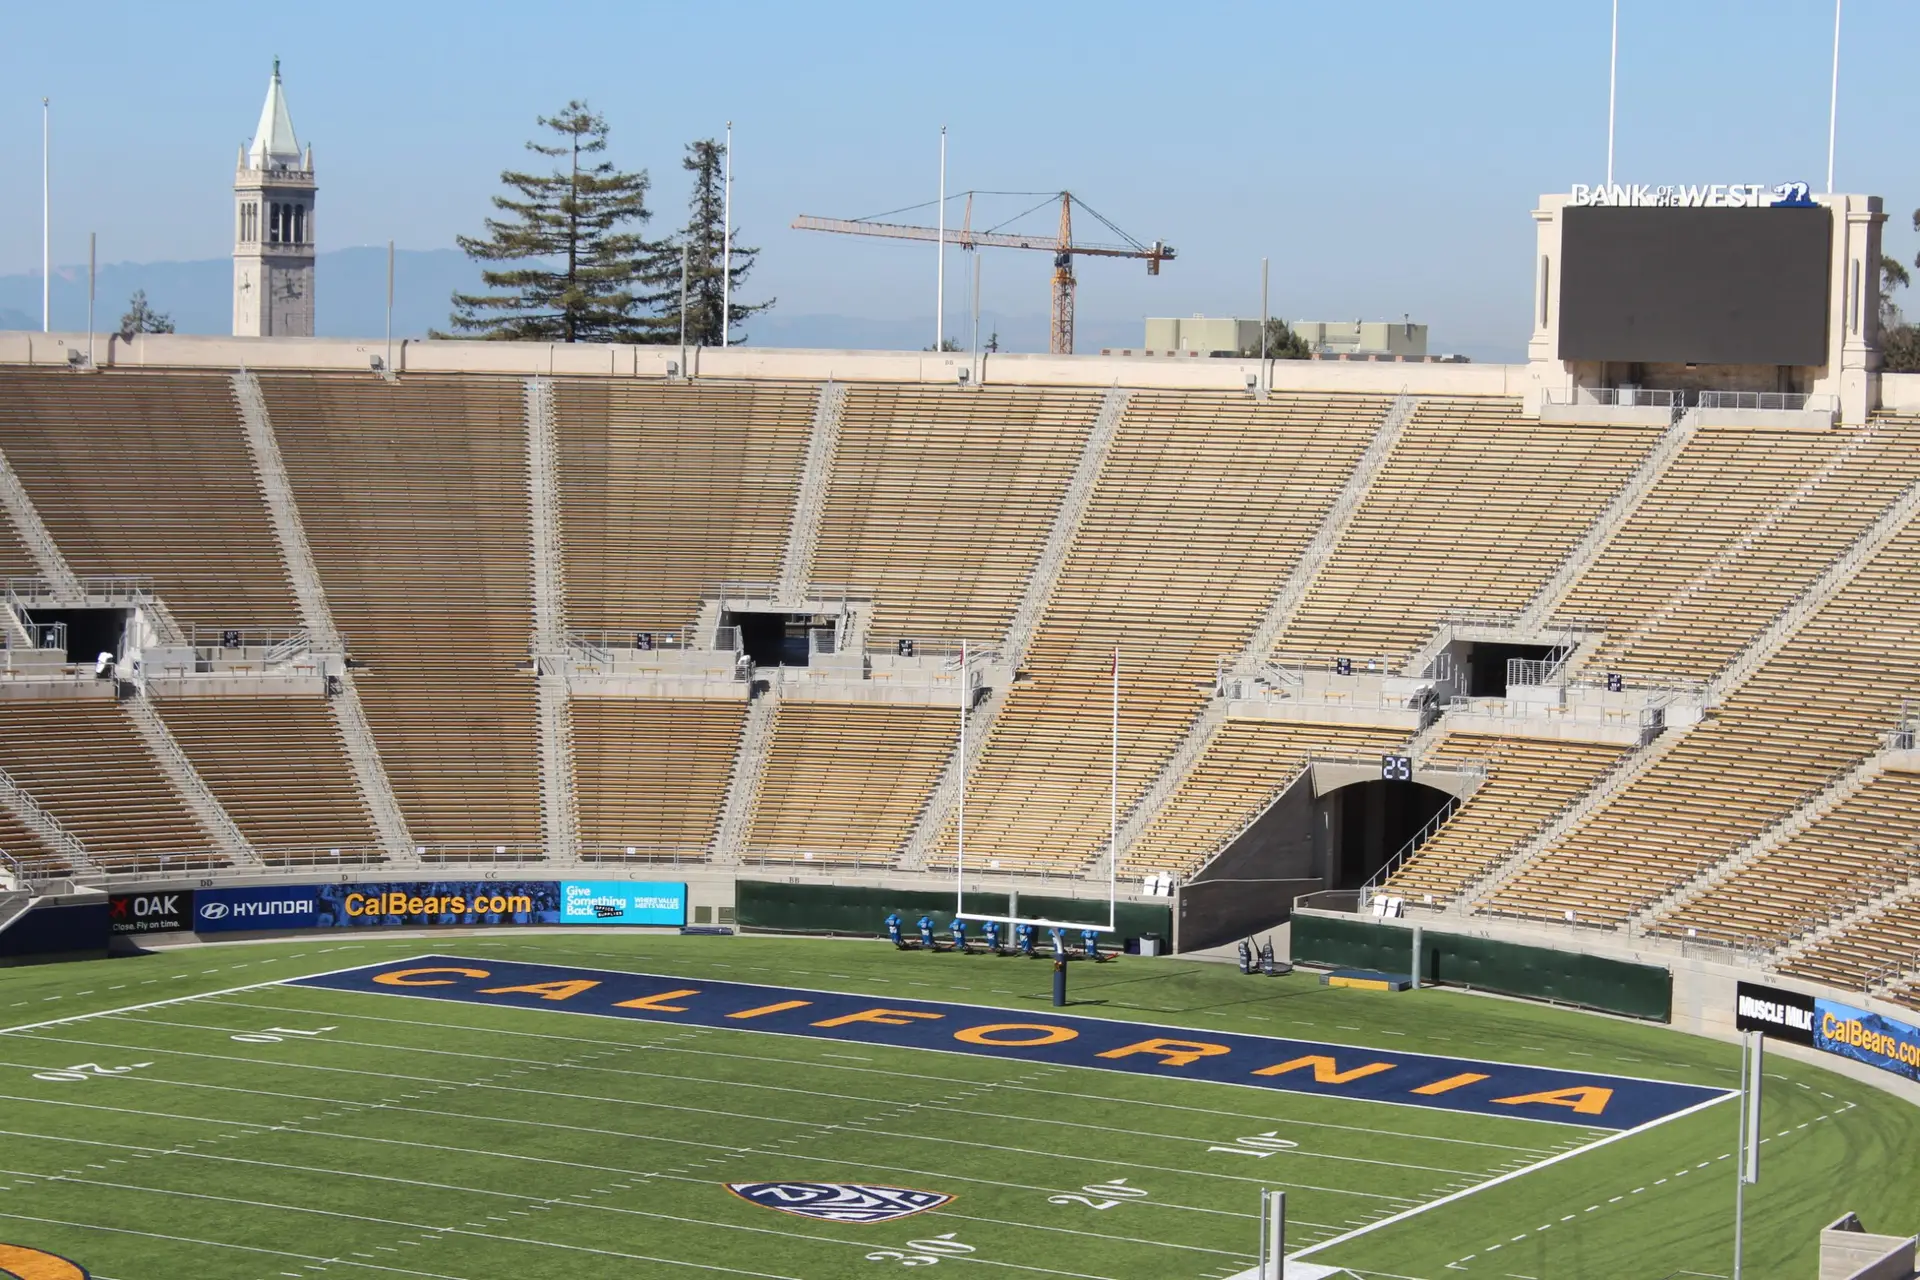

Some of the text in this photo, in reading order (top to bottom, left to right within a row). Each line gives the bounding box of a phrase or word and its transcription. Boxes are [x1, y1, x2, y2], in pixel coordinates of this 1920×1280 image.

[1571, 184, 1651, 207] BANK
[1657, 185, 1676, 195] OF
[1680, 184, 1764, 208] WEST
[1653, 194, 1679, 207] THE
[1383, 756, 1409, 780] 25
[200, 879, 213, 887] DD
[484, 871, 498, 879] CC
[629, 872, 635, 880] C
[566, 885, 591, 897] Give
[134, 895, 179, 917] OAK
[233, 900, 313, 917] HYUNDAI
[344, 892, 532, 916] CalBears.com
[566, 895, 627, 909] Something
[566, 905, 594, 916] Back
[113, 922, 136, 931] Close.
[136, 921, 148, 931] Fly
[160, 920, 180, 929] time.
[1738, 995, 1813, 1031] MUSCLE MILK
[230, 1026, 322, 1043] 10
[372, 967, 1615, 1115] CALIFORNIA
[1822, 1012, 1920, 1067] CalBears.co
[32, 1062, 132, 1082] 20
[1206, 1136, 1299, 1159] 10
[1047, 1183, 1148, 1210] 20
[864, 1238, 977, 1266] 30
